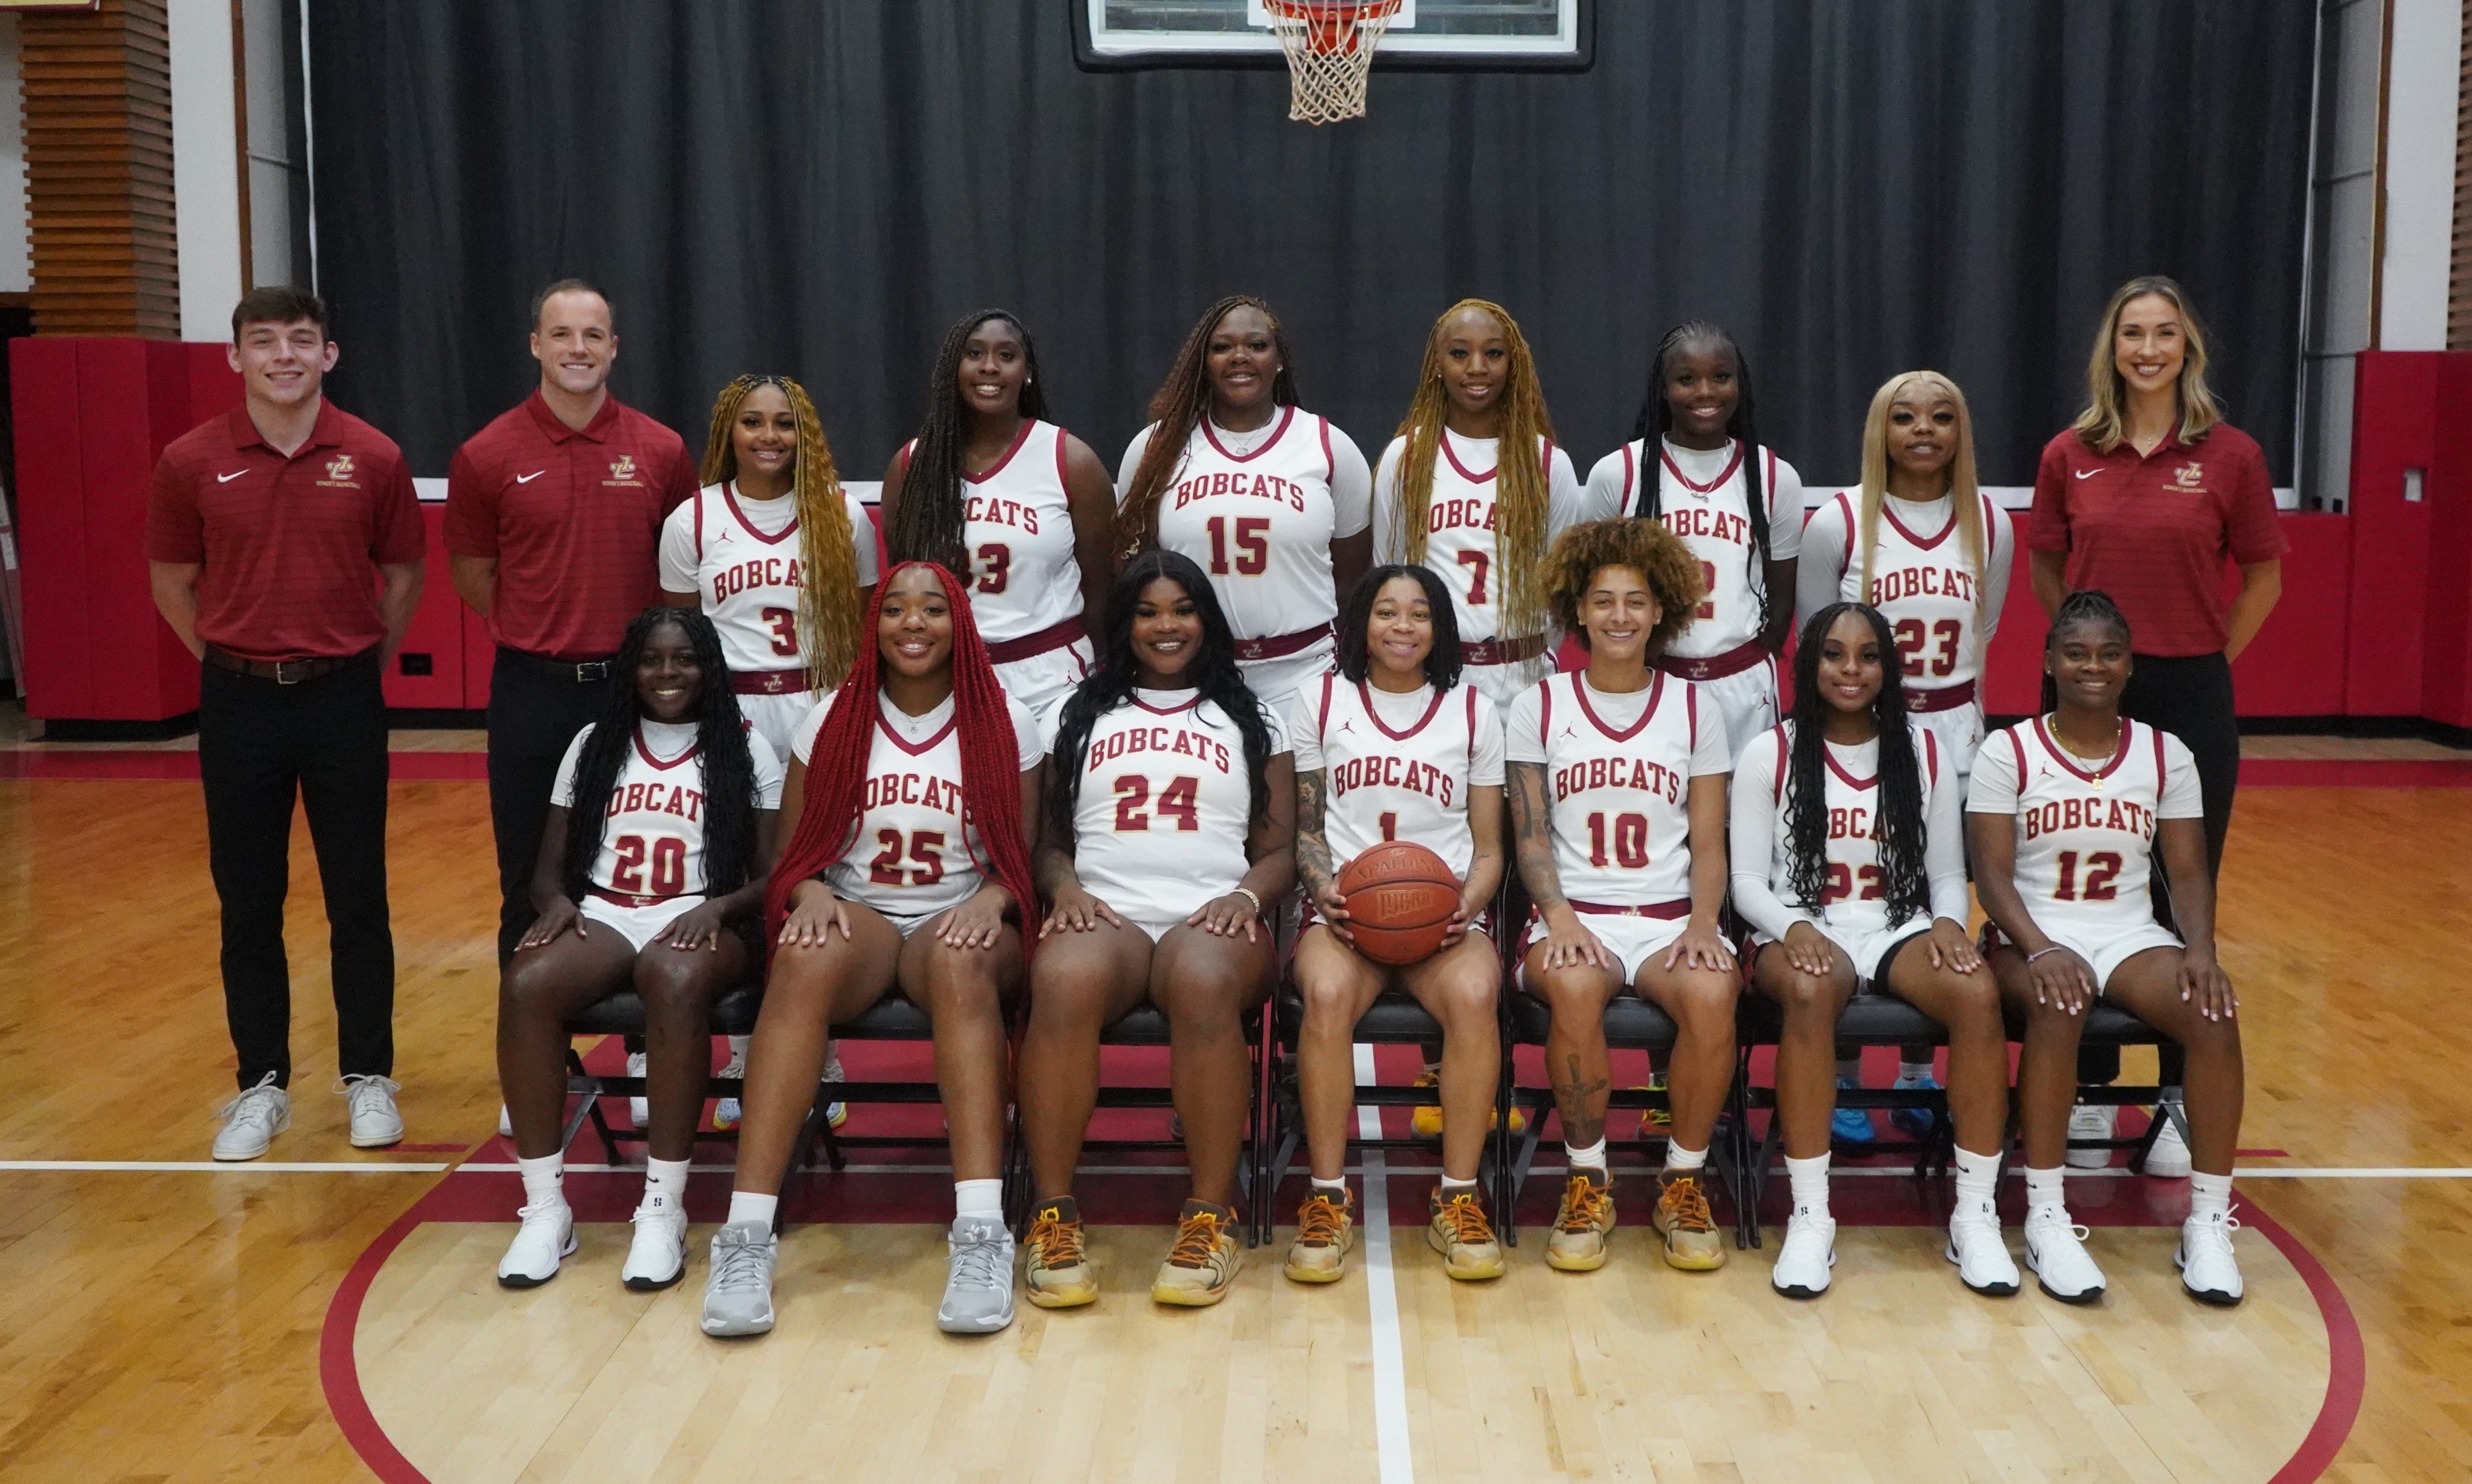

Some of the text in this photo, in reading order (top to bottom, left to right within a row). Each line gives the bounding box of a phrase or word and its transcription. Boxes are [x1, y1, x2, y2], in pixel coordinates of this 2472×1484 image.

[962, 497, 1038, 535] CATS
[1175, 472, 1304, 513] BOBCATS
[1205, 515, 1271, 577] 15
[713, 557, 808, 605] BOBCA
[1456, 549, 1490, 606] 7
[1870, 566, 1981, 608] BOBCAT
[761, 607, 799, 656] 3
[1895, 618, 1962, 677] 23
[1090, 727, 1230, 774] BOBCATS
[607, 782, 704, 823] OBCAT
[853, 773, 974, 825] OBCAT
[1113, 774, 1201, 833] 24
[1334, 755, 1454, 807] BOBCATS
[1556, 758, 1679, 805] BOBCATS
[1377, 810, 1398, 842] 1
[1586, 810, 1649, 869] 10
[2026, 797, 2153, 842] BOBCATS
[609, 834, 687, 895] 20
[870, 828, 946, 887] 25
[1358, 857, 1446, 881] SPALDING
[2053, 850, 2122, 902] 12
[1819, 862, 1890, 906] 22
